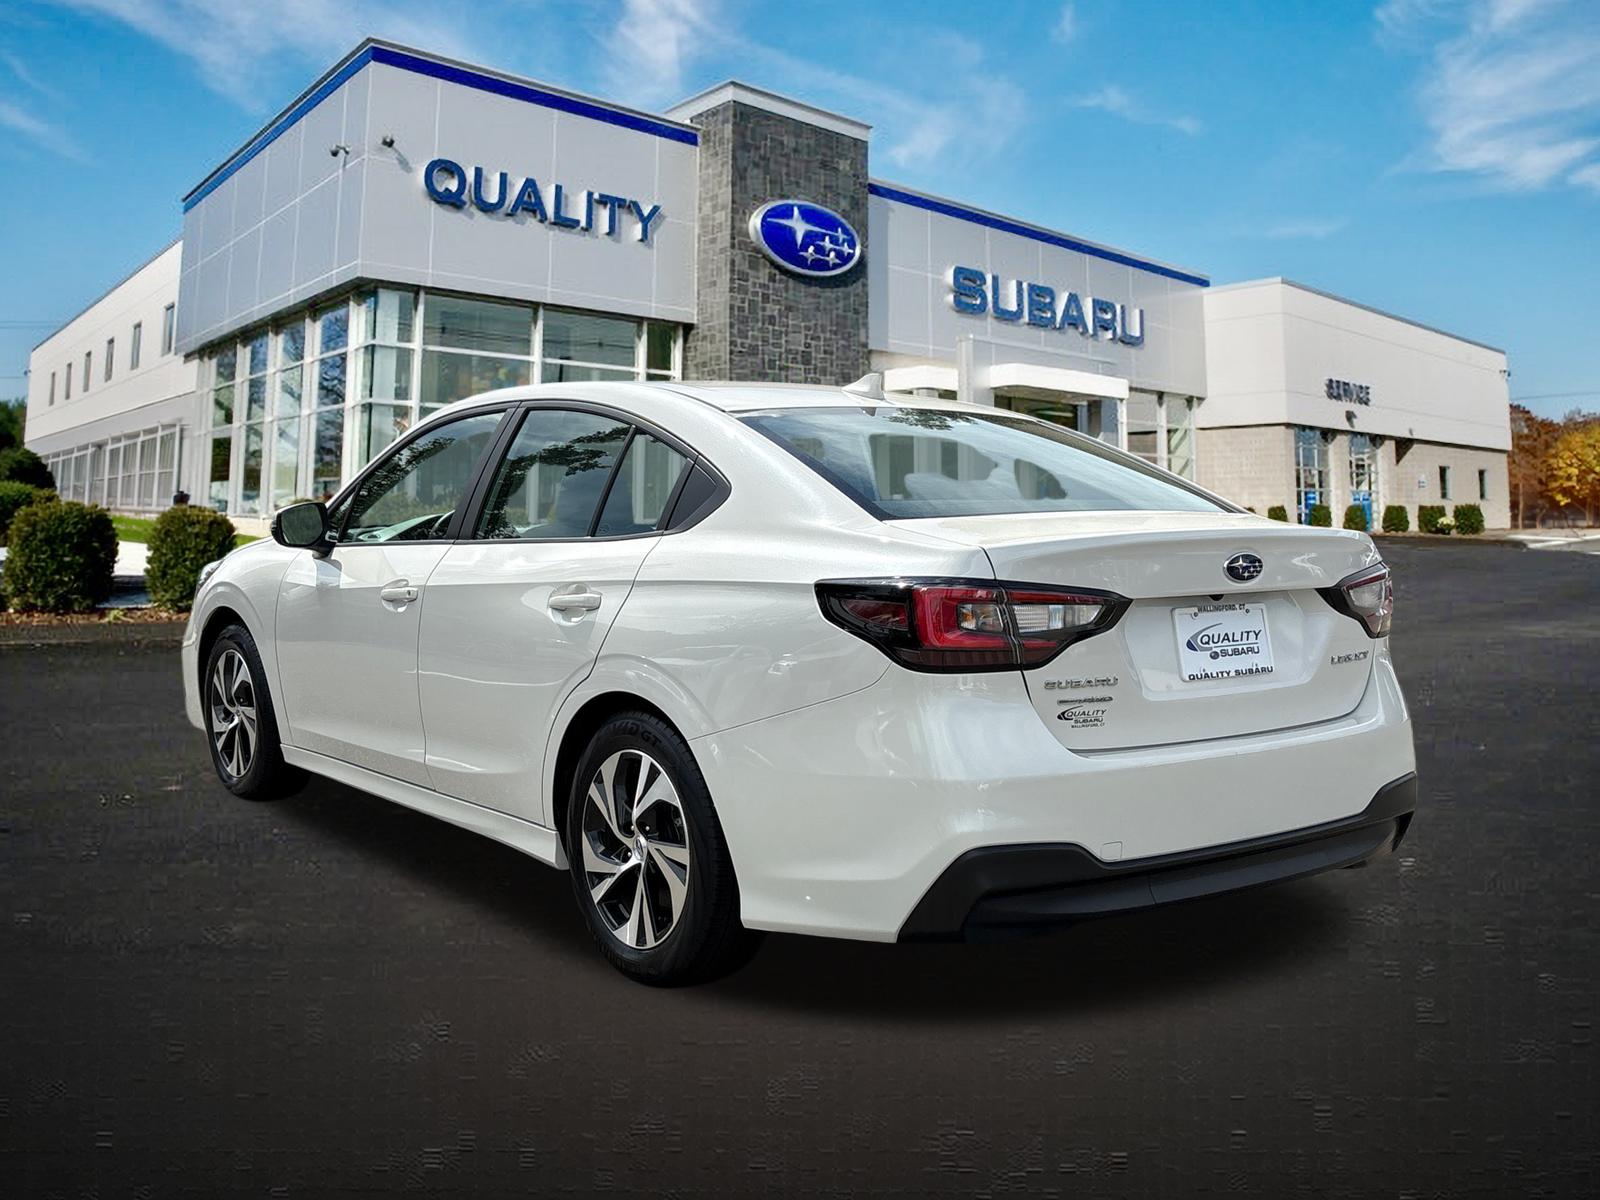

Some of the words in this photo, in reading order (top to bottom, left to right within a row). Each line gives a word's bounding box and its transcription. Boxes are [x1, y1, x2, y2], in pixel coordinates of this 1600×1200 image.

[424, 158, 662, 242] QUALITY
[949, 265, 1145, 346] SUBARU
[1200, 629, 1262, 646] QUALITY
[1220, 646, 1260, 658] SUBARU
[1188, 670, 1231, 681] QUALITY
[1234, 665, 1274, 676] SUBARU
[1043, 676, 1119, 690] SUBARU
[1066, 709, 1107, 718] QUALITY
[1073, 717, 1104, 725] SUBARU
[640, 730, 663, 747] GT
